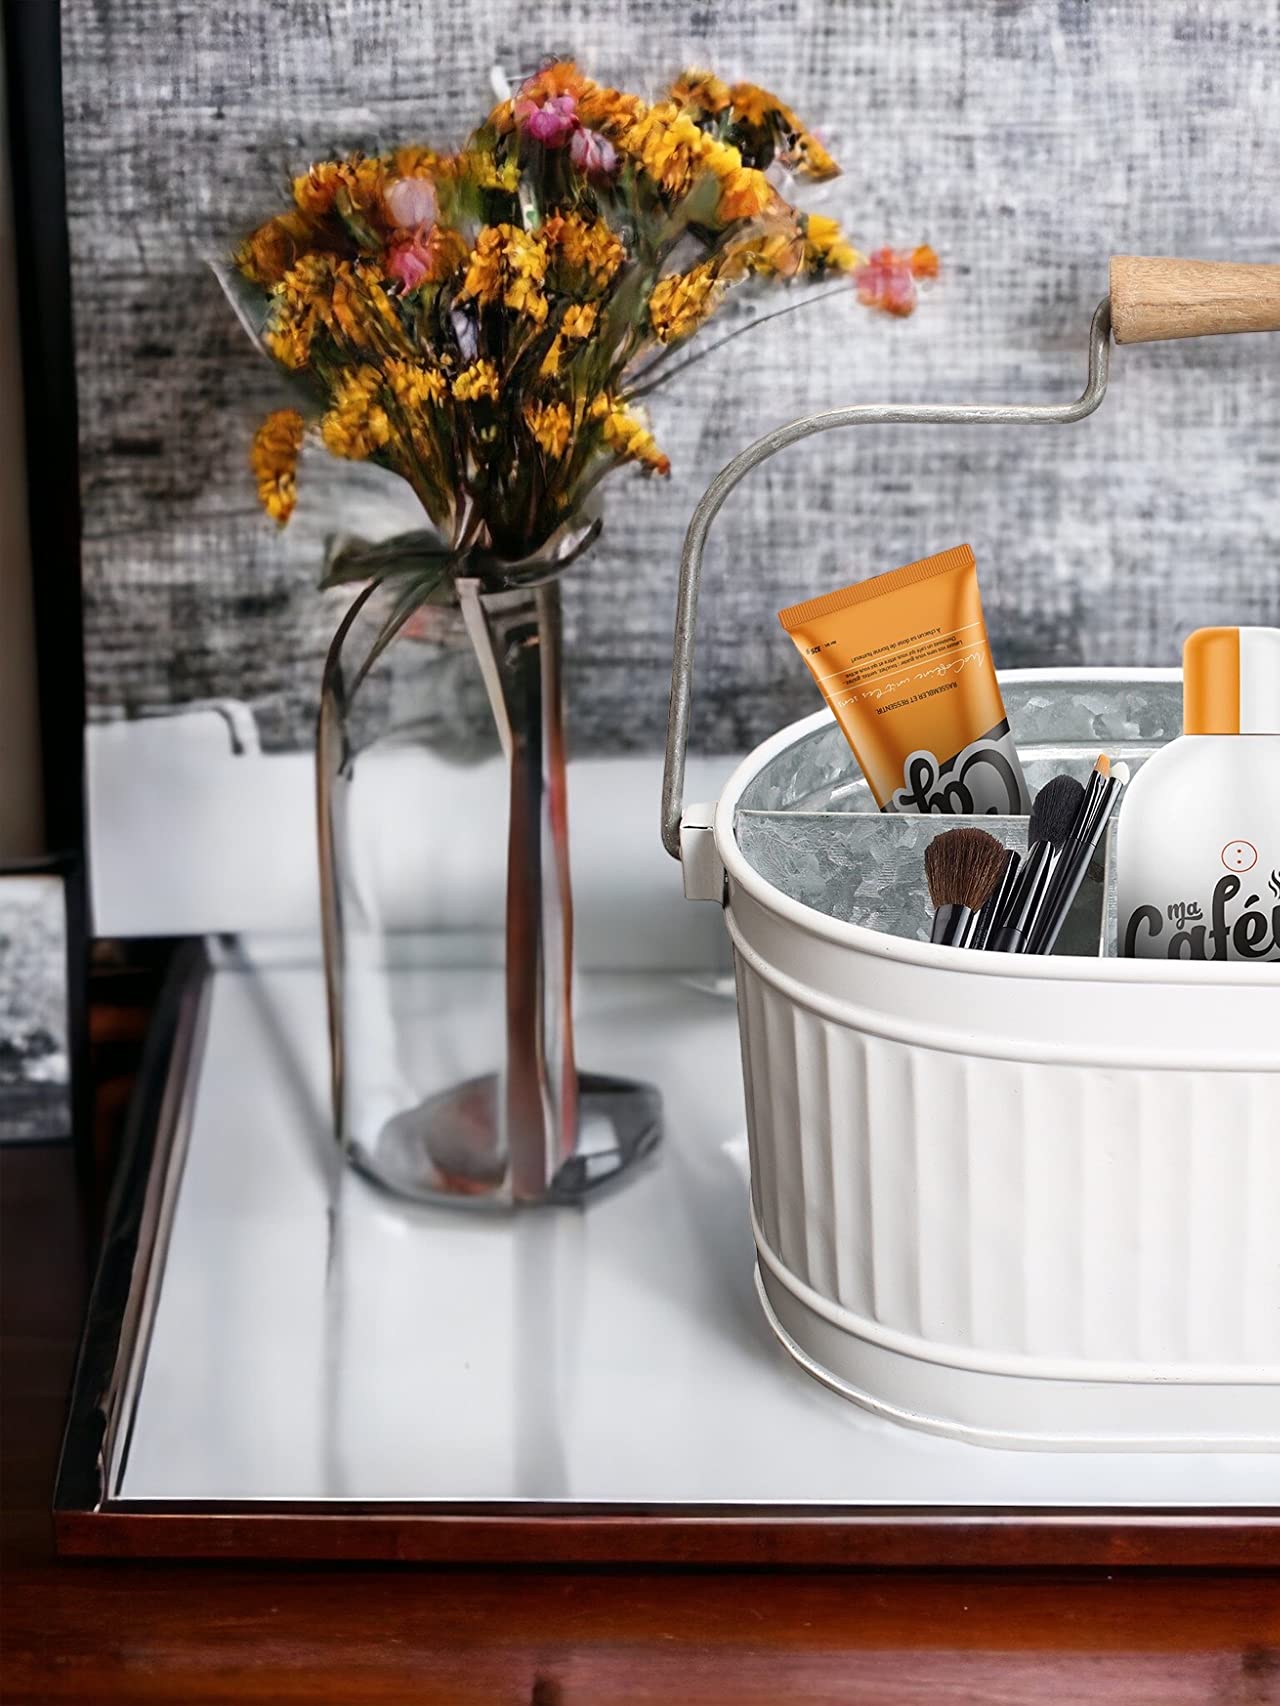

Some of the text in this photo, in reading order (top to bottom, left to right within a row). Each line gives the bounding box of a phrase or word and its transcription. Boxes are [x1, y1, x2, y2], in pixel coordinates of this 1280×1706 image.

[876, 681, 957, 715] RASSEMBLER ET RESSENTIR
[1167, 901, 1202, 929] ma
